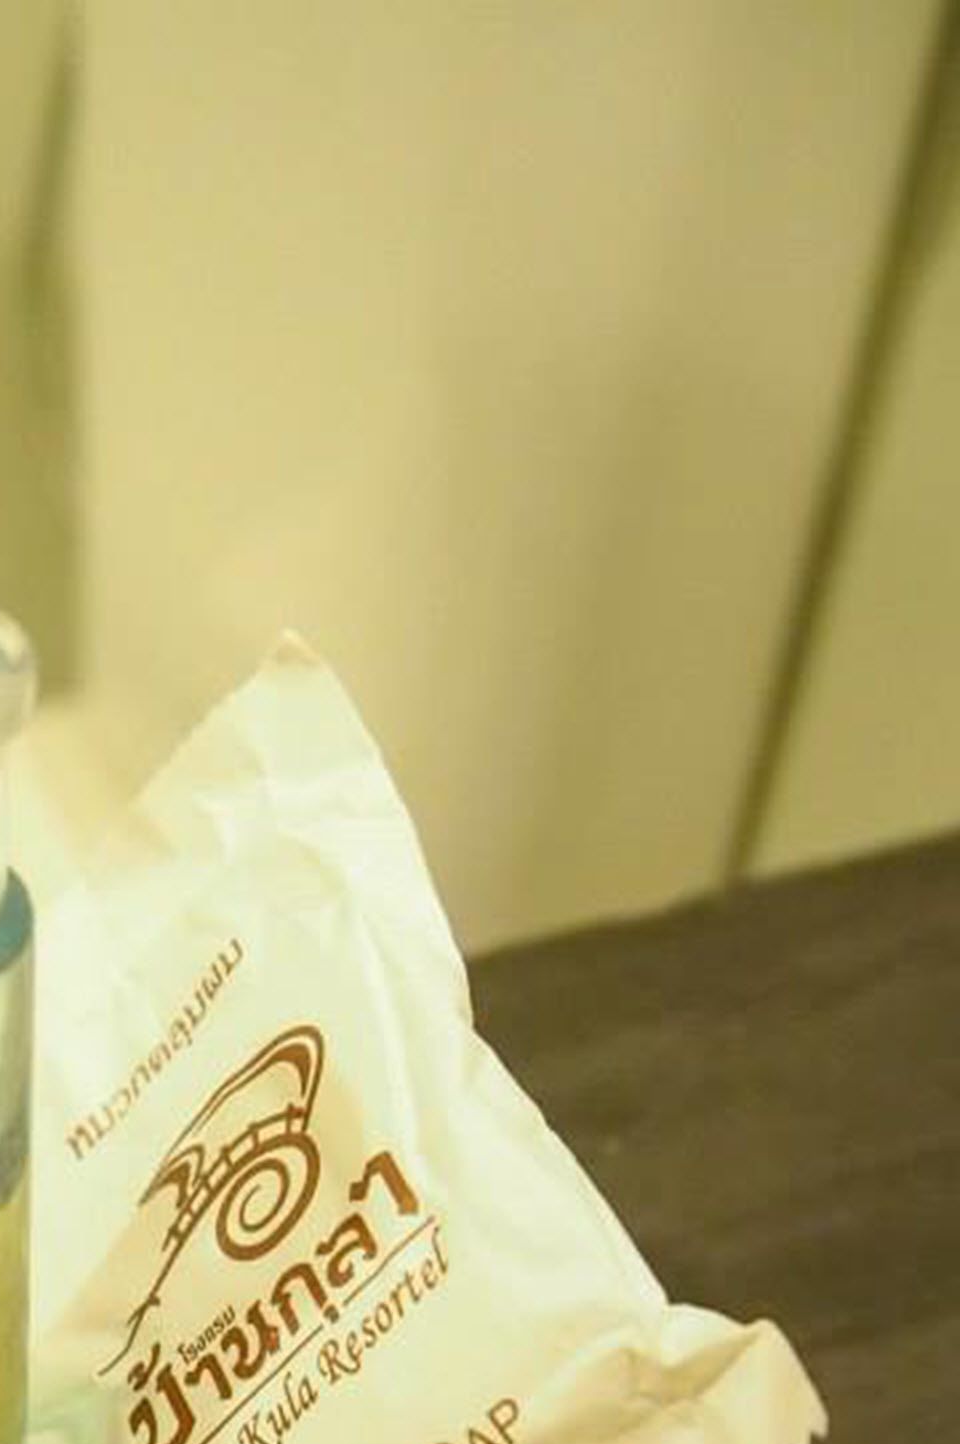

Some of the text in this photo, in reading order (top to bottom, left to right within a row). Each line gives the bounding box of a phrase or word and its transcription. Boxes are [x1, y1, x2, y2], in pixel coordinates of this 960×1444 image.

[178, 1305, 237, 1367] โรงแรม
[317, 1226, 449, 1385] Resortel
